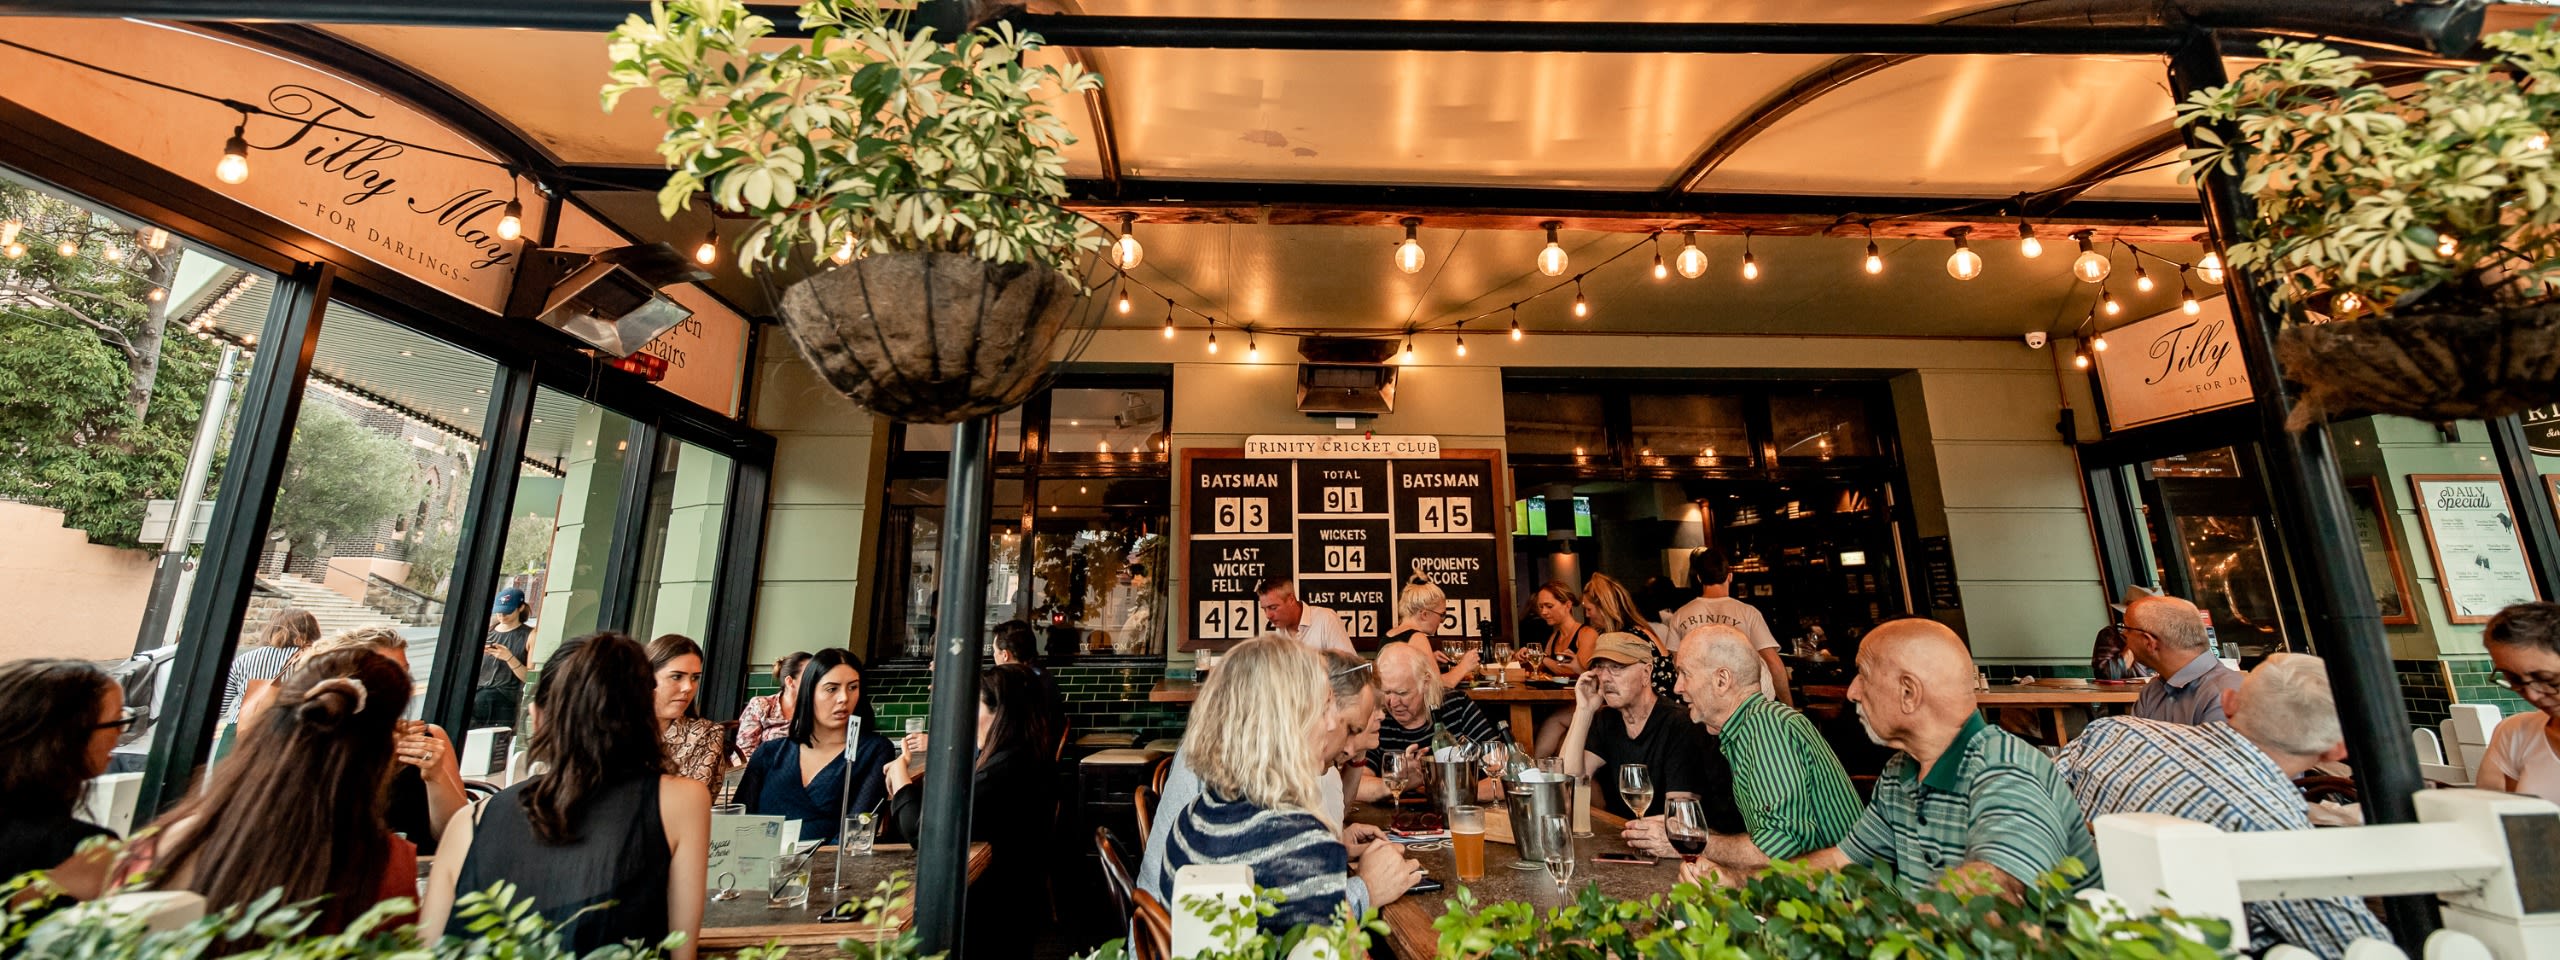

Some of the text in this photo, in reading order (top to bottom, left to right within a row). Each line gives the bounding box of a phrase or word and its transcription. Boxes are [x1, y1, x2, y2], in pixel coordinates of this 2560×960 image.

[247, 84, 404, 206] Tilly
[368, 227, 459, 281] DARLINGS
[2144, 318, 2232, 386] Tilly
[1248, 441, 1437, 454] TRINITY CRICKET CLUB
[1201, 474, 1278, 488] BATSMAN
[1323, 470, 1360, 480] TOTAL
[1403, 473, 1479, 488] BATSMAN
[2446, 486, 2484, 498] DAILY
[1327, 491, 1358, 509] 91
[2437, 489, 2492, 512] Specials
[1219, 504, 1263, 527] 63
[1425, 505, 1468, 527] 45
[1320, 529, 1367, 541] WICKETS
[1223, 548, 1259, 561] LAST
[1328, 551, 1361, 567] 04
[1213, 563, 1265, 577] WICKET
[1411, 557, 1480, 571] OPPONENTS
[1427, 571, 1468, 585] SCORE
[1212, 579, 1243, 592] FELL
[1308, 591, 1384, 603] LAST PLAYER
[1680, 614, 1741, 631] TRINITY
